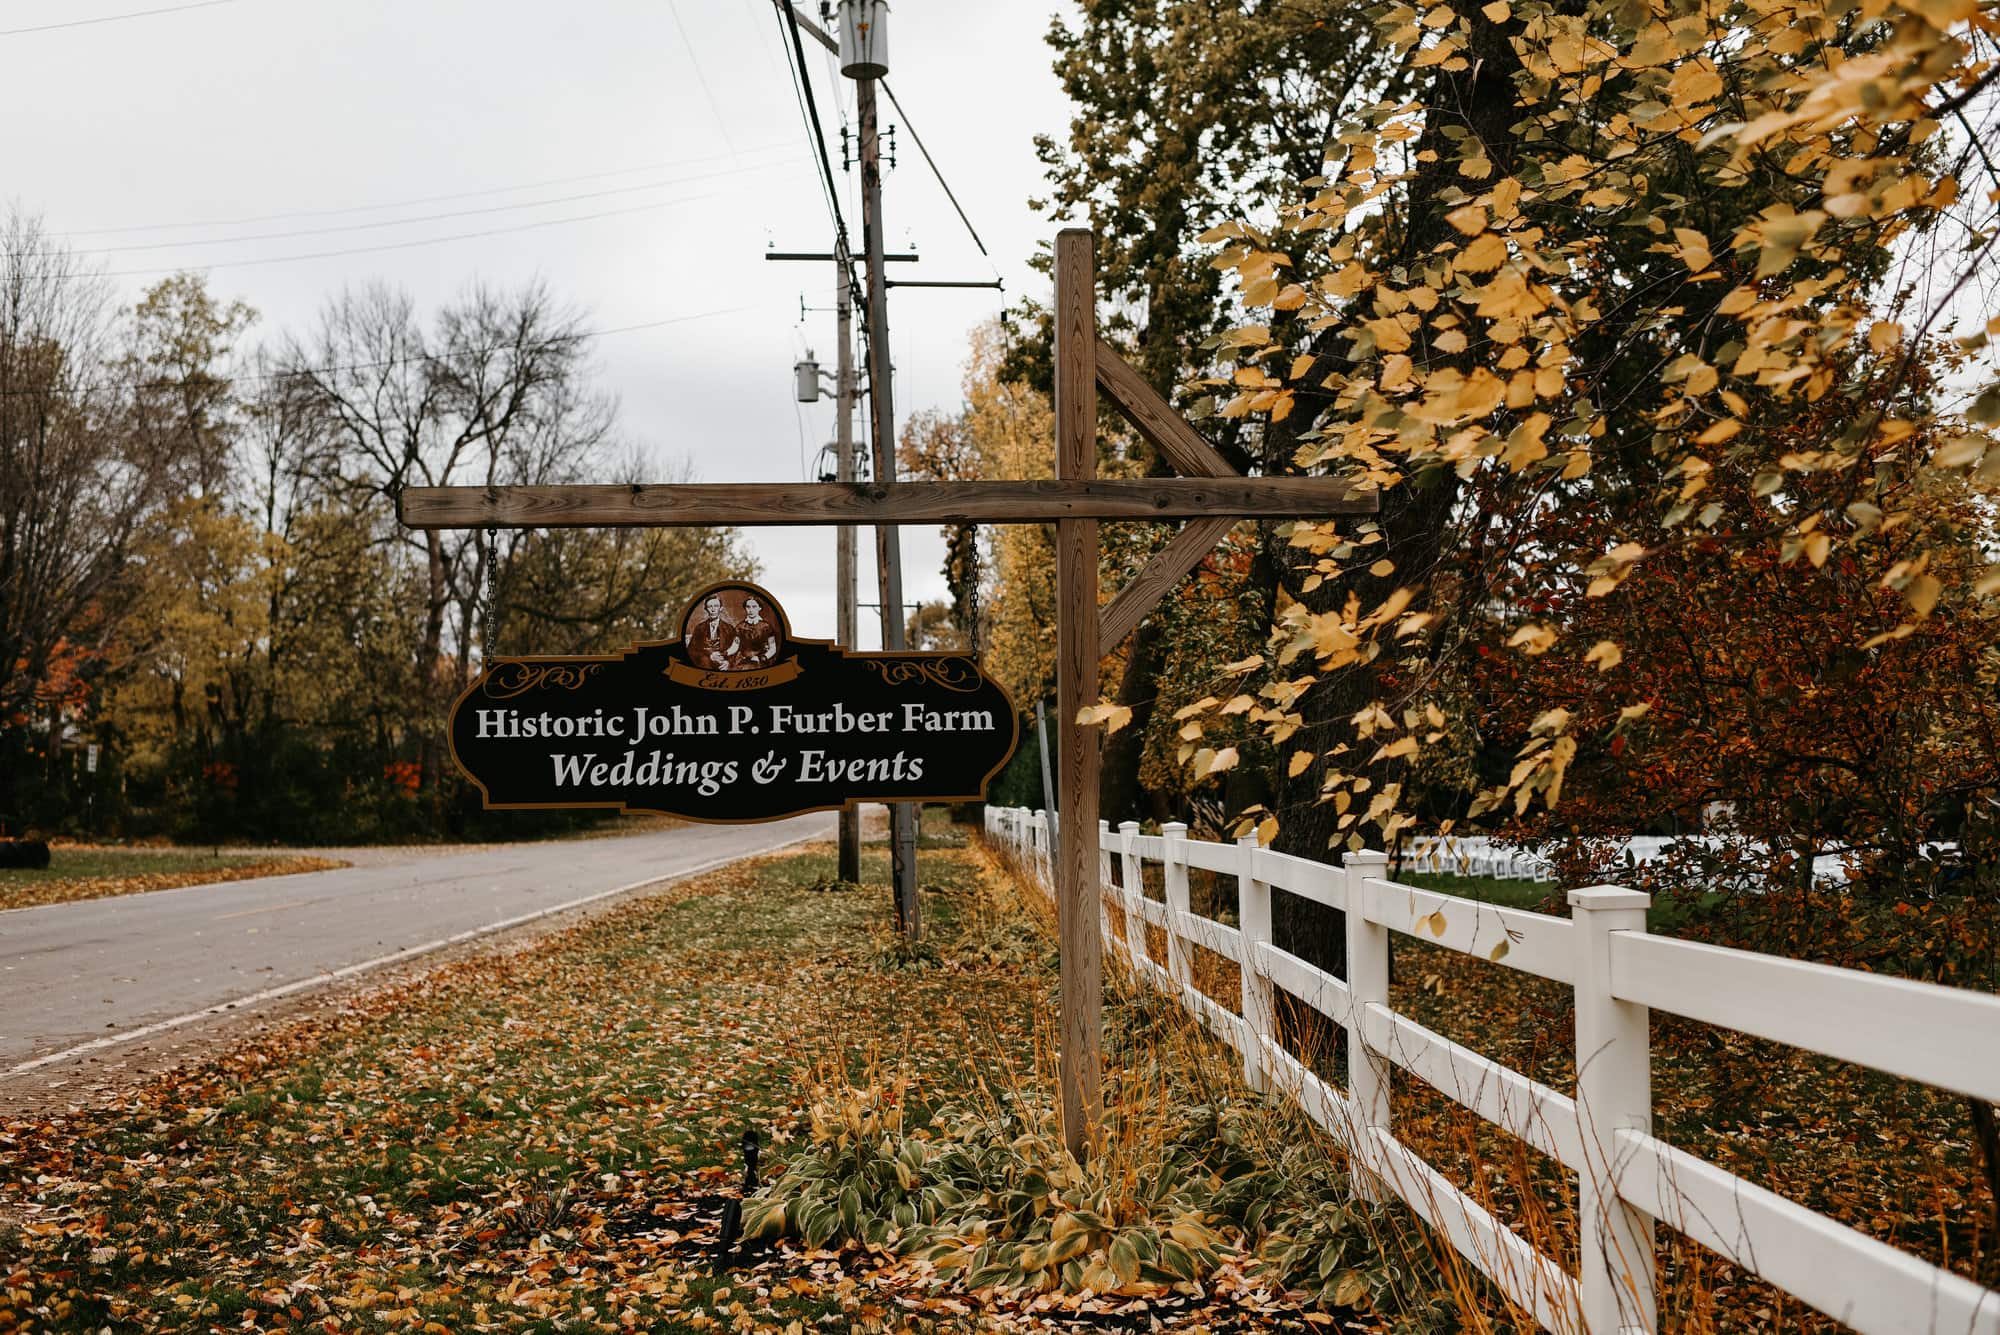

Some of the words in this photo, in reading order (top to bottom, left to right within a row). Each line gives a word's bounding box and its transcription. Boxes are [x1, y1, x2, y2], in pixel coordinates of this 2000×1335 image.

[698, 671, 729, 689] Est.
[735, 675, 769, 689] 1850
[475, 708, 625, 740] Historic
[628, 704, 720, 747] John
[727, 705, 760, 736] P.
[768, 702, 894, 735] Furber
[900, 702, 996, 732] Farm
[550, 750, 739, 798] Weddings
[751, 749, 787, 783] &
[795, 750, 924, 784] Events
